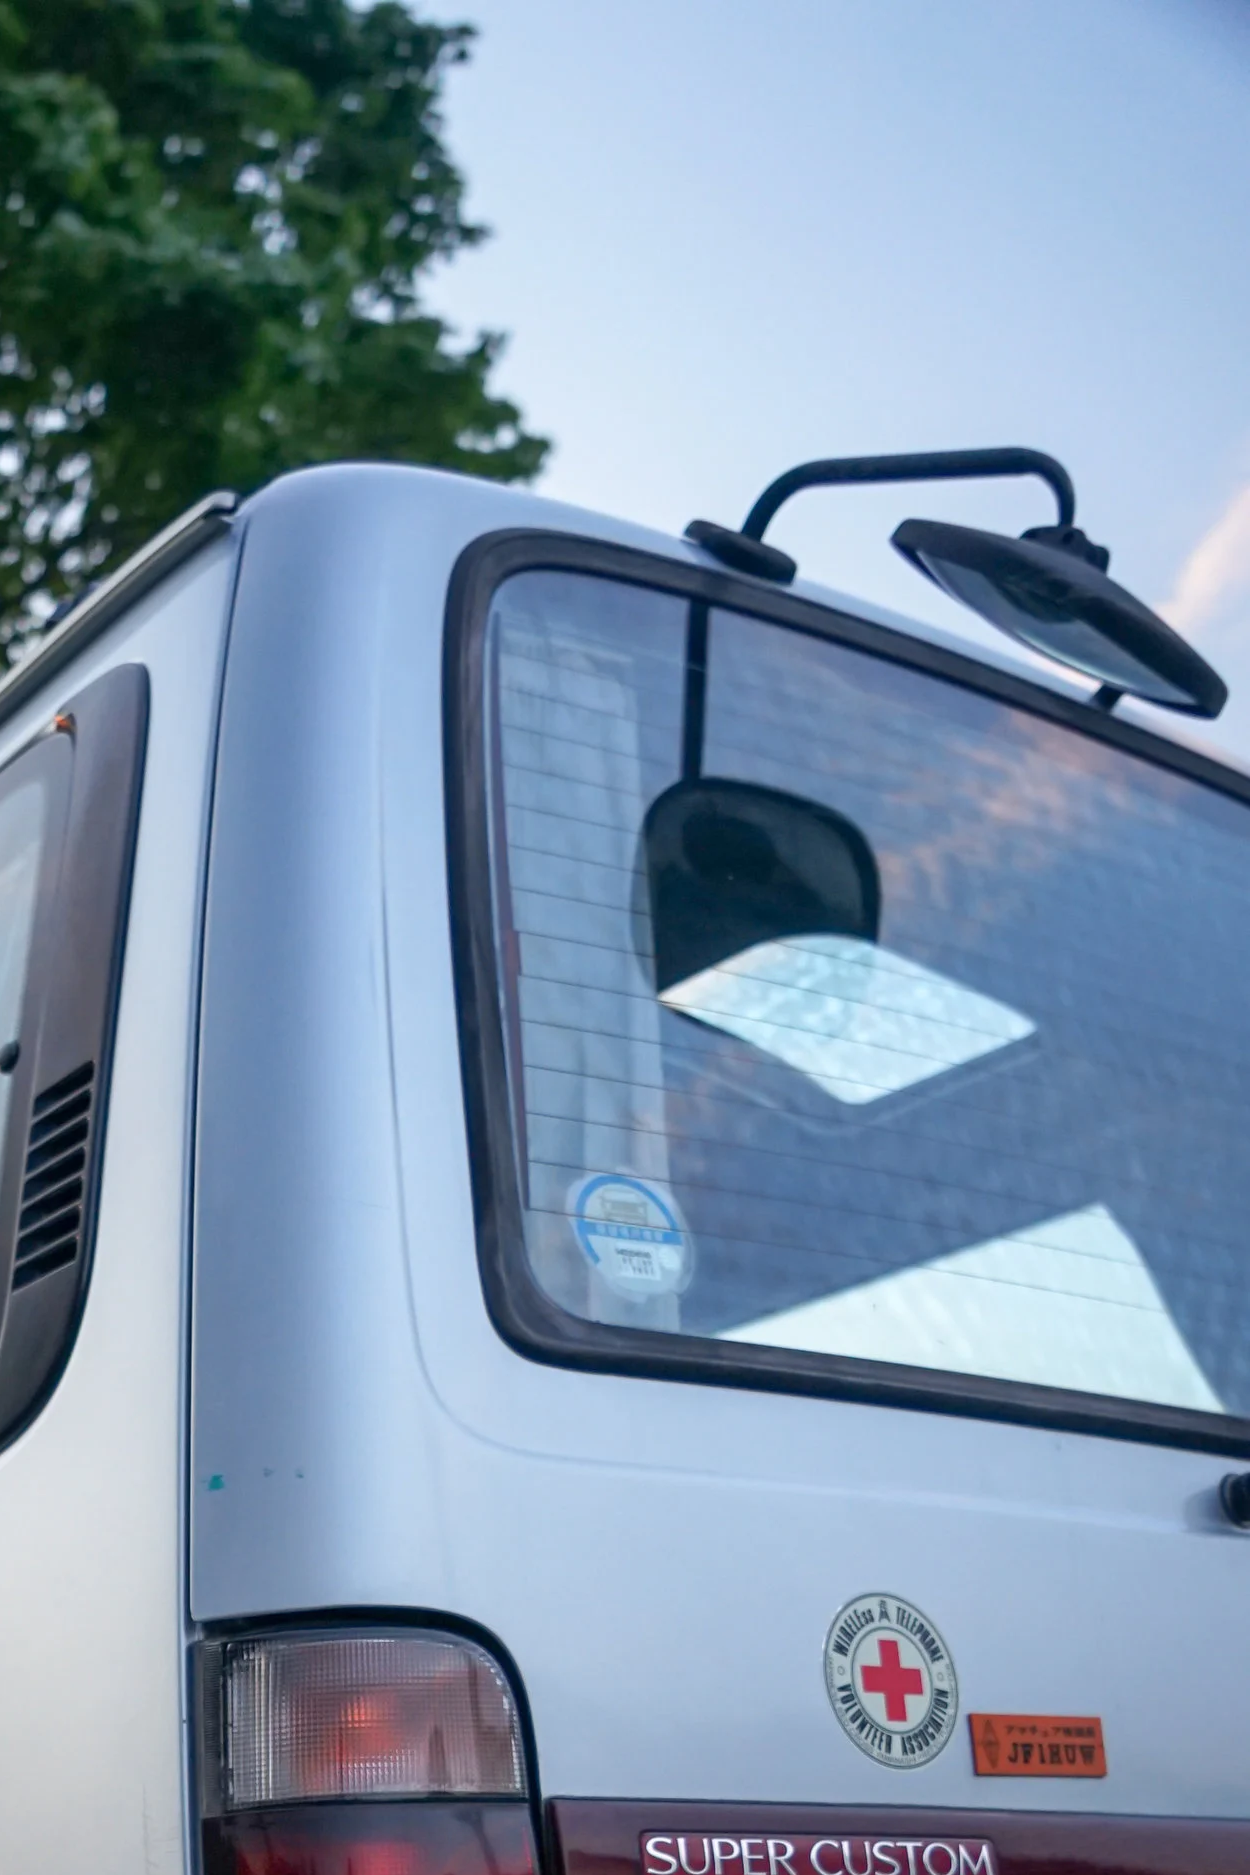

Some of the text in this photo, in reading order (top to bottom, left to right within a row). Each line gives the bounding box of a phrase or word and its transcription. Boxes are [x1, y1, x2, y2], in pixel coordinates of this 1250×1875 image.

[896, 1605, 945, 1664] TELEPHONE
[836, 1683, 893, 1754] VOLUNTEER
[901, 1687, 949, 1757] ASSOCIATION
